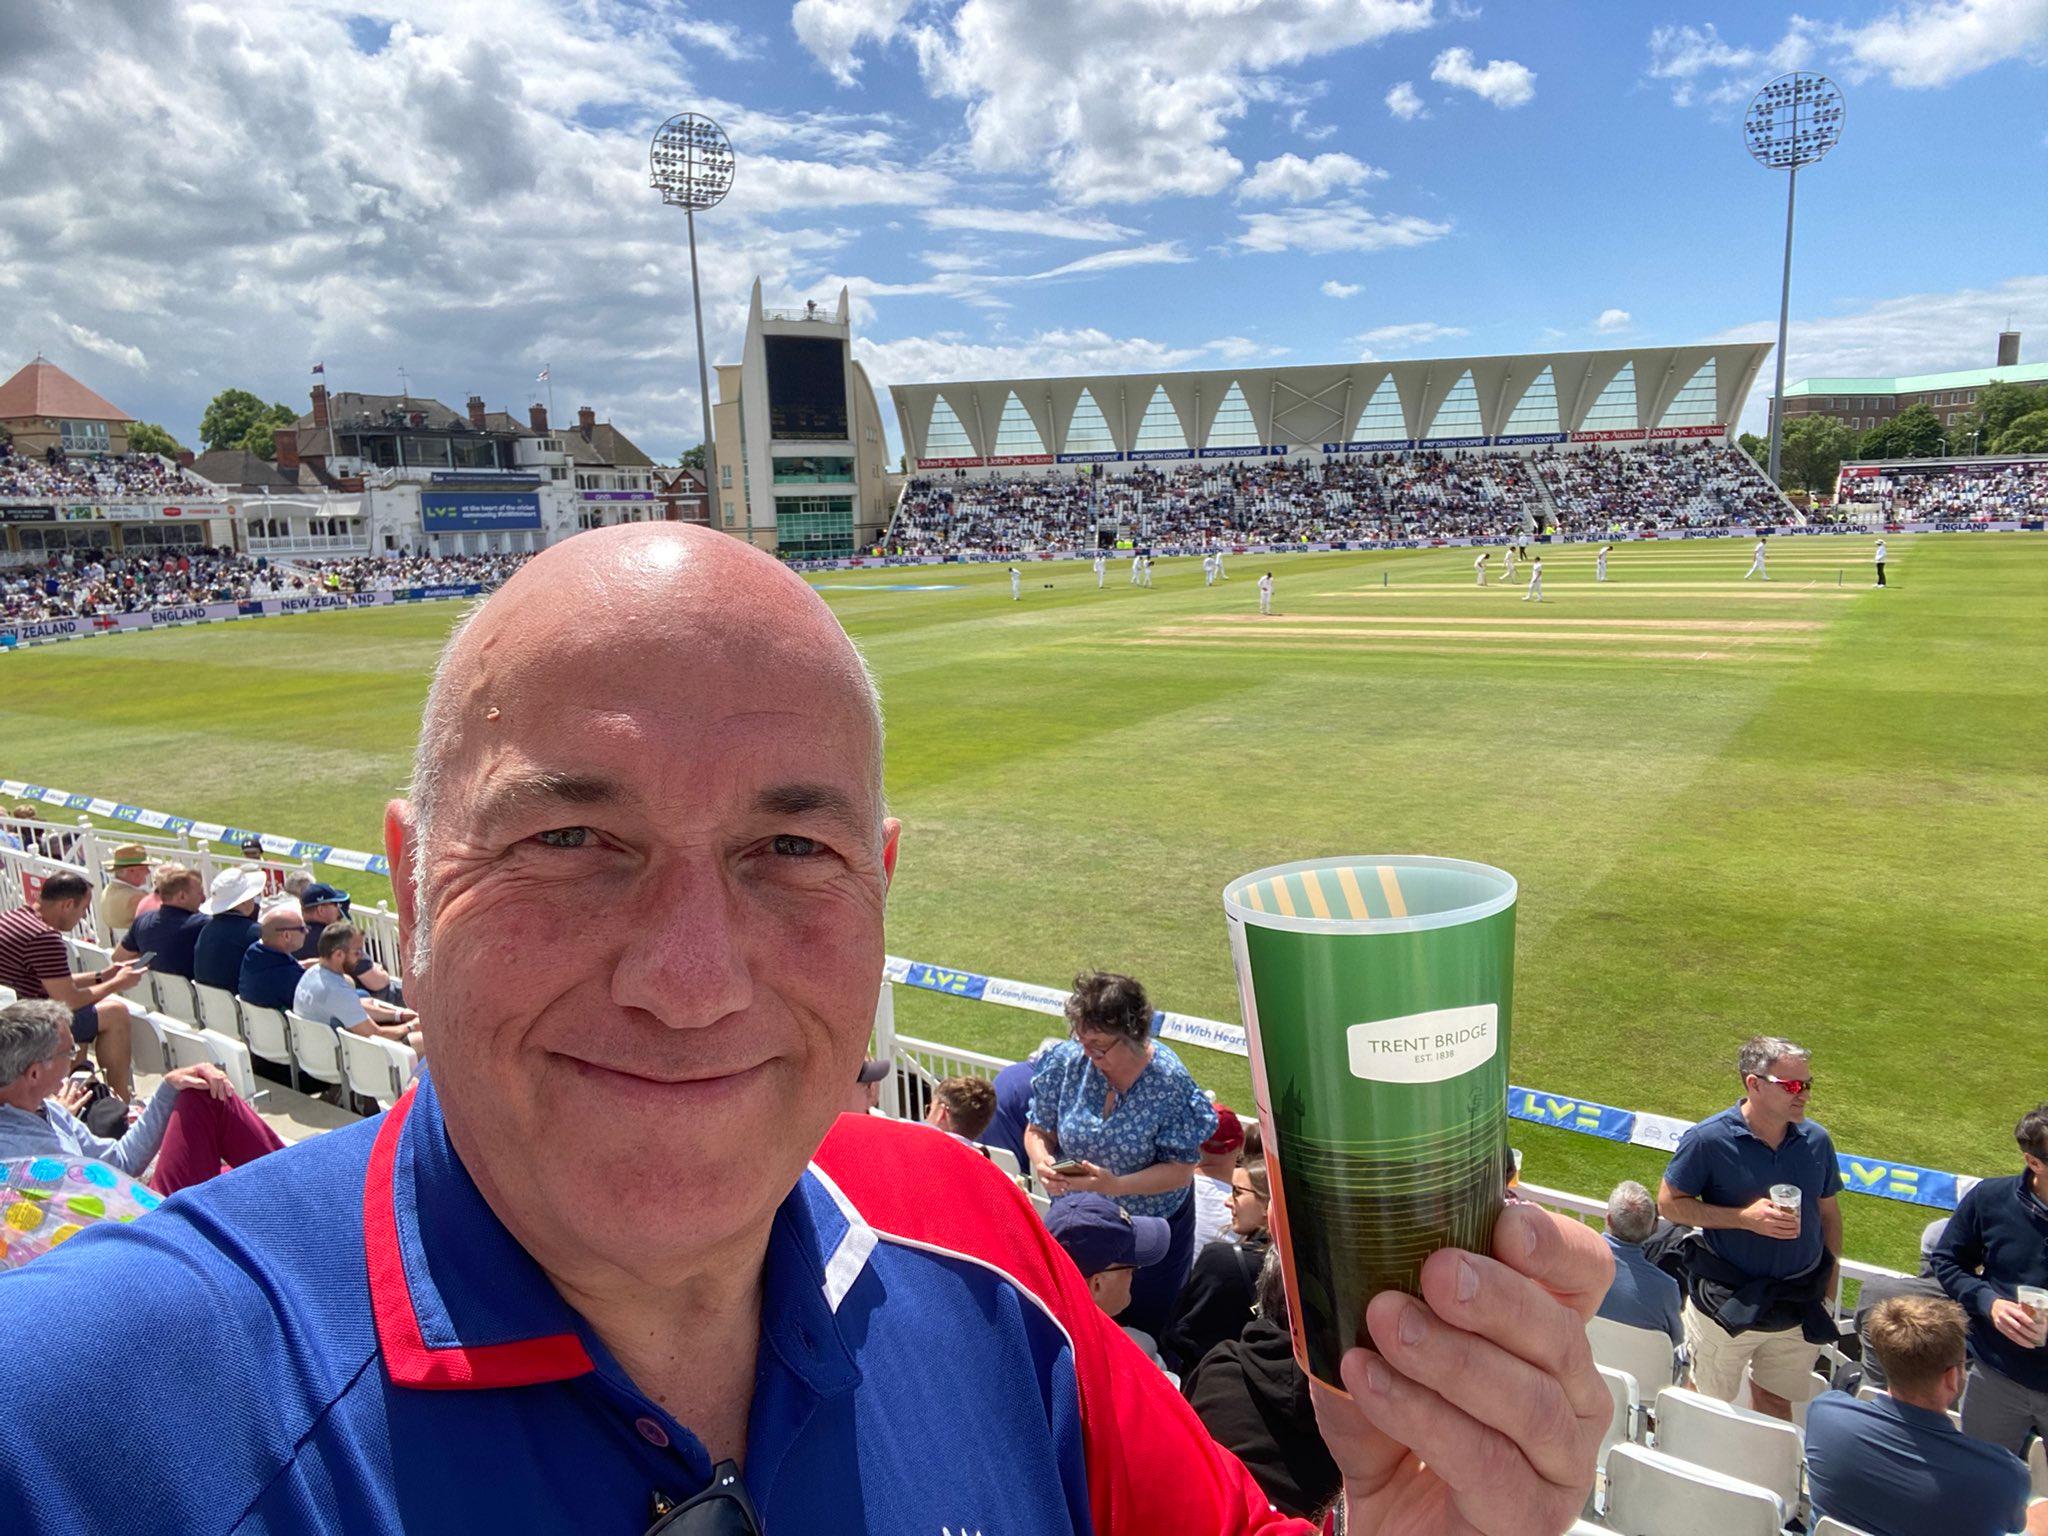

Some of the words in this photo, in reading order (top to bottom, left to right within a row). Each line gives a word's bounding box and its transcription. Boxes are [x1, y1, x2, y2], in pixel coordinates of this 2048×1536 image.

[1572, 432, 1592, 441] John
[1594, 432, 1610, 441] Pye
[1612, 429, 1645, 439] Auctions
[1650, 429, 1670, 438] John
[1672, 428, 1688, 437] Pye
[1691, 426, 1724, 436] Auctions
[1534, 434, 1562, 442] COOPER
[1790, 526, 1815, 535] NEW
[1817, 525, 1868, 534] ZEALAND
[1935, 522, 1989, 531] ENGLAND
[1563, 535, 1582, 543] NEW
[1586, 533, 1627, 542] ZEALAND
[1684, 529, 1730, 538] ENGLAND
[1358, 541, 1377, 549] NEW
[1380, 540, 1419, 549] ZEALAND
[1471, 537, 1511, 546] ENGLAND
[1270, 544, 1309, 552] ENGLAND
[969, 553, 987, 562] NEW
[989, 552, 1028, 561] ZEALAND
[1075, 551, 1114, 559] ENGLAND
[884, 556, 923, 565] ENGLAND
[281, 597, 311, 610] NEW
[313, 593, 376, 608] ZEALAND
[152, 607, 206, 624] ENGLAND
[22, 621, 76, 639] ZEALAND
[1171, 1021, 1182, 1032] In
[1185, 1023, 1212, 1038] With
[1213, 1030, 1247, 1046] Heart
[1368, 1036, 1430, 1053] TRENT
[1435, 1022, 1487, 1048] BRIDGE
[1414, 1053, 1433, 1063] EST.
[1436, 1050, 1455, 1061] 1838
[1523, 1094, 1602, 1129] LV=
